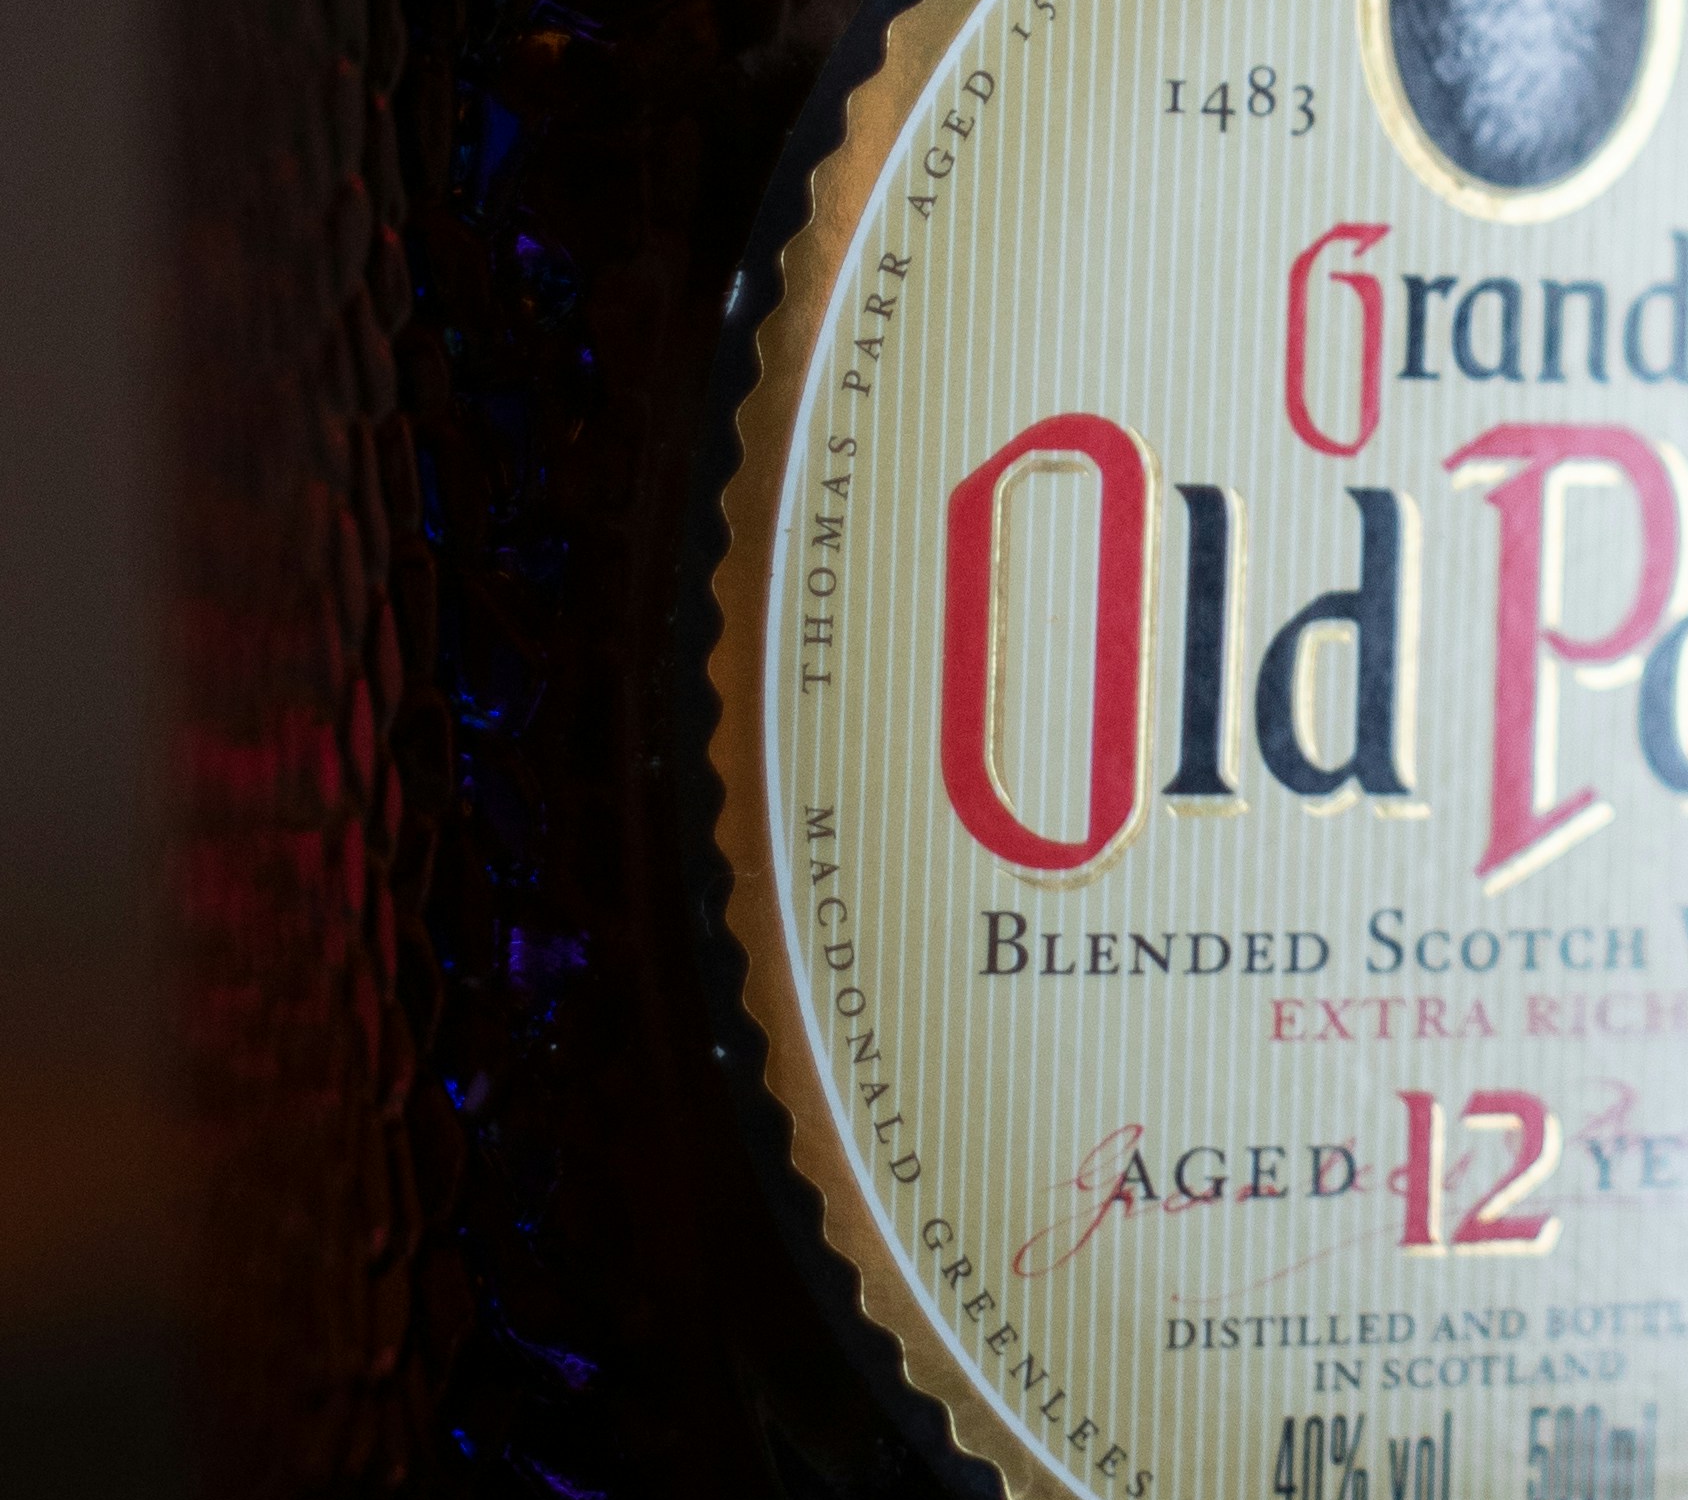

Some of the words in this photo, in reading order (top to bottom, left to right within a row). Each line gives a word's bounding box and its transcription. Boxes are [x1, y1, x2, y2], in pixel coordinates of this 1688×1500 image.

[1164, 64, 1317, 136] 1483
[801, 434, 858, 694] THOMAS
[841, 250, 912, 398] PARR
[906, 68, 997, 220] AGED
[940, 412, 1426, 886] Old
[978, 908, 1331, 976] BLENDED
[1365, 906, 1647, 974] SCOTCH
[1268, 996, 1496, 1042] EXTRA
[803, 804, 923, 1187] MACDONALD
[921, 1215, 1154, 1500] GREENLEES
[1111, 1144, 1358, 1202] AGED
[1396, 1088, 1562, 1254] 12
[1166, 1310, 1416, 1351] DISTILLED
[1432, 1305, 1527, 1343] AND
[1314, 1357, 1362, 1392] IN
[1381, 1349, 1629, 1390] SCOTLAND
